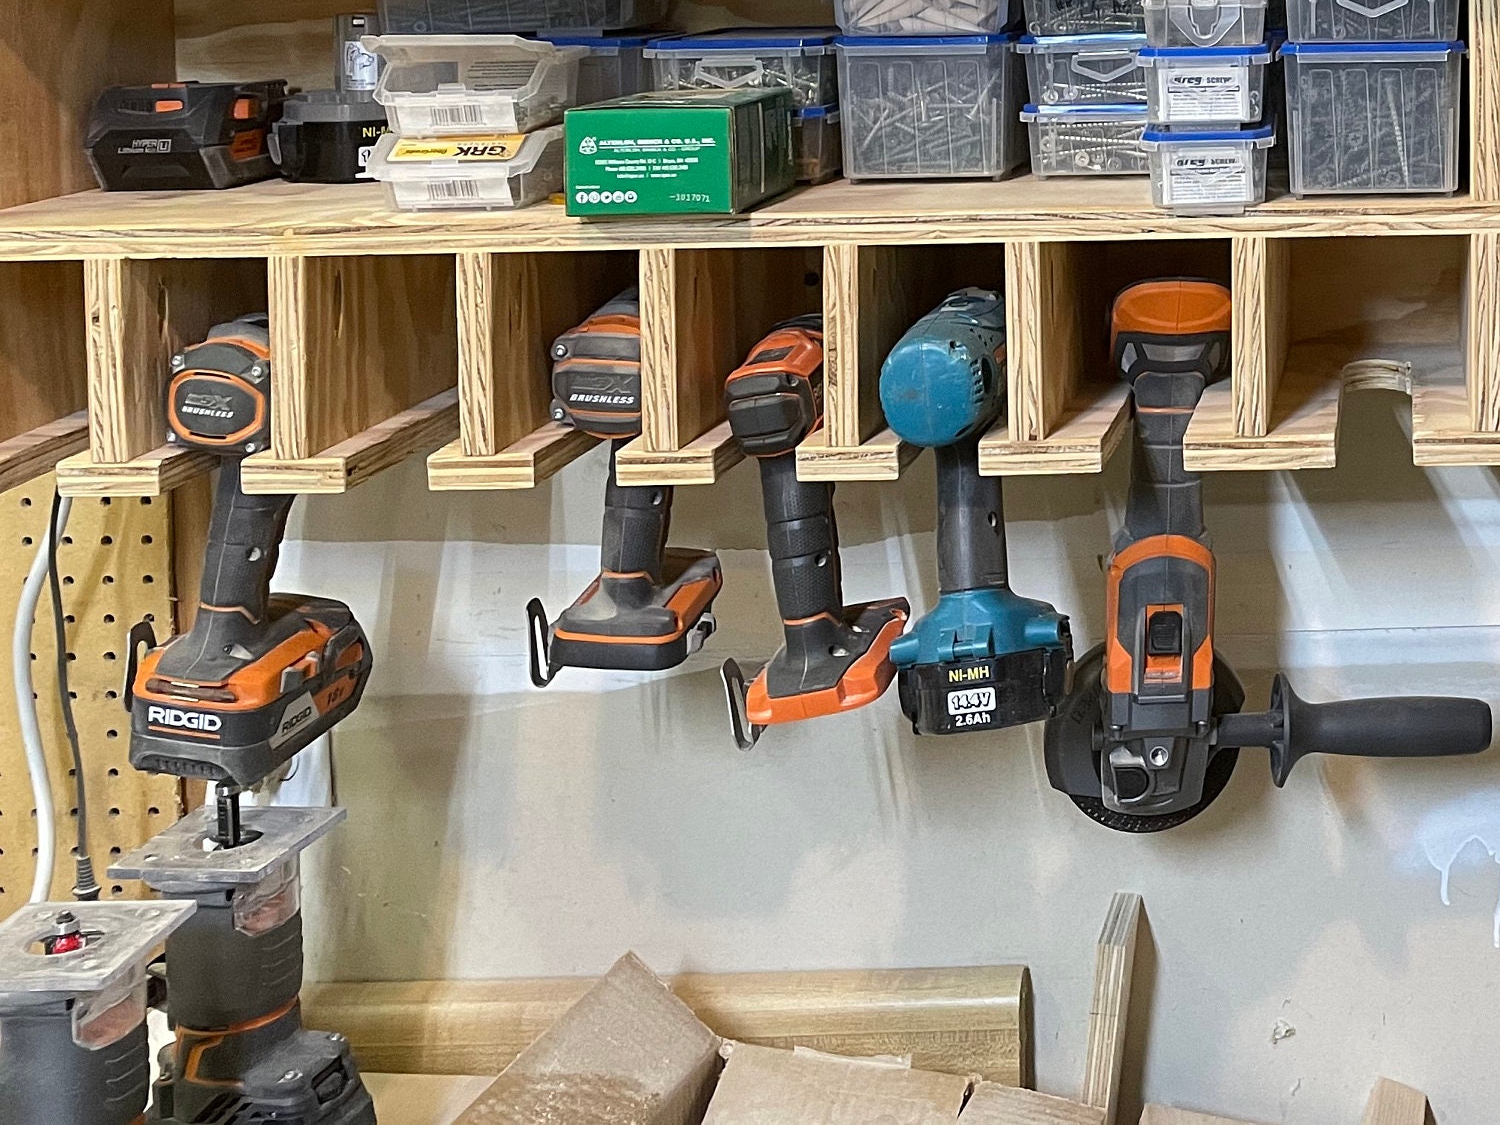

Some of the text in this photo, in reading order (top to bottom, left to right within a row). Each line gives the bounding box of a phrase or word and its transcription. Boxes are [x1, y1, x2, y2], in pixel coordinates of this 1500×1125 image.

[453, 145, 508, 157] GRK
[569, 393, 635, 404] BRUSHLESS
[181, 405, 234, 419] BRUSHLESS
[948, 665, 990, 683] NI-MH
[951, 691, 991, 711] 14.4V
[148, 706, 222, 732] RIDGID
[281, 706, 312, 734] RIDGID
[955, 711, 991, 727] 2.6Ah
